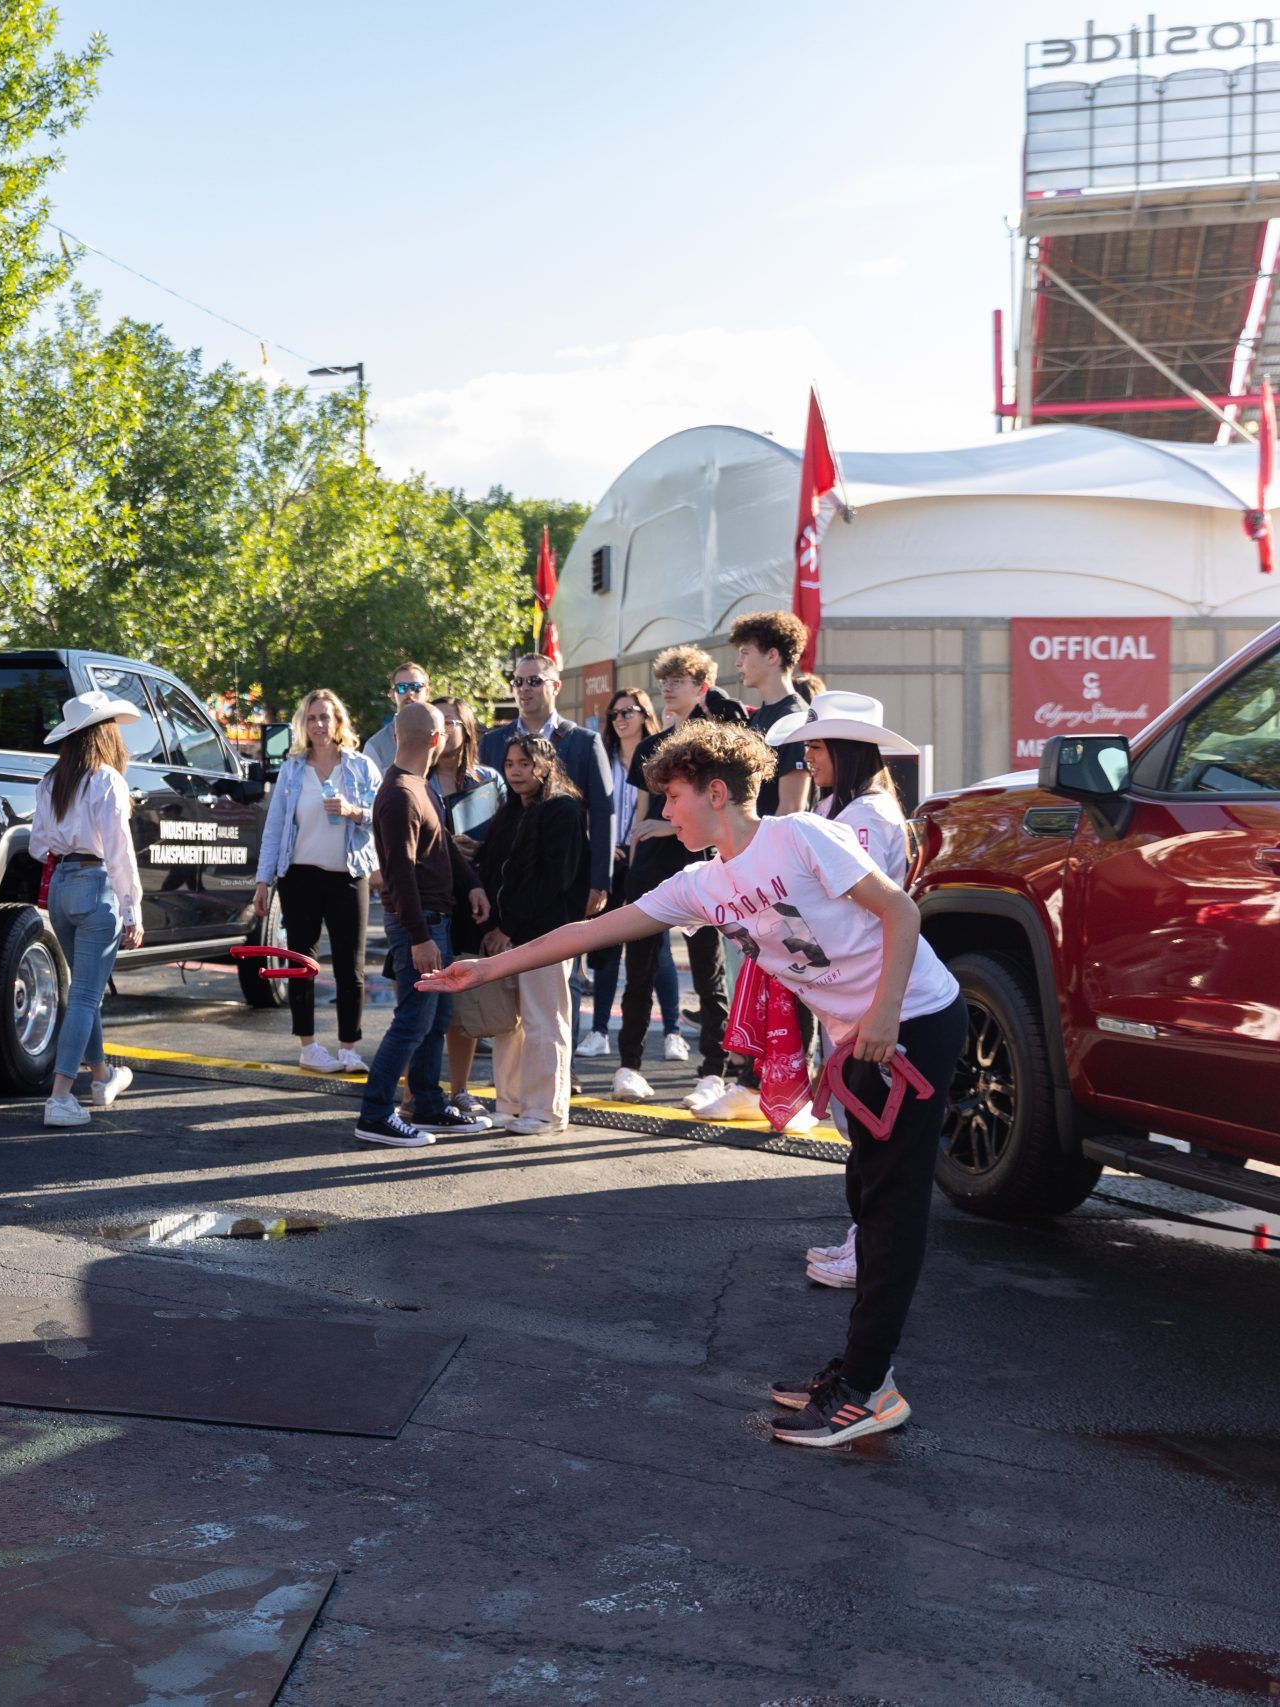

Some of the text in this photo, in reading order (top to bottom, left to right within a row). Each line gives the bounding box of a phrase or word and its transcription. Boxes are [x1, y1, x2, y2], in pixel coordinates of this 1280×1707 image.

[1029, 635, 1156, 660] OFFICIAL
[160, 820, 218, 841] INDUSTRY-FIRST
[149, 845, 204, 865] TRANSPARENT
[203, 846, 231, 865] TRAILER
